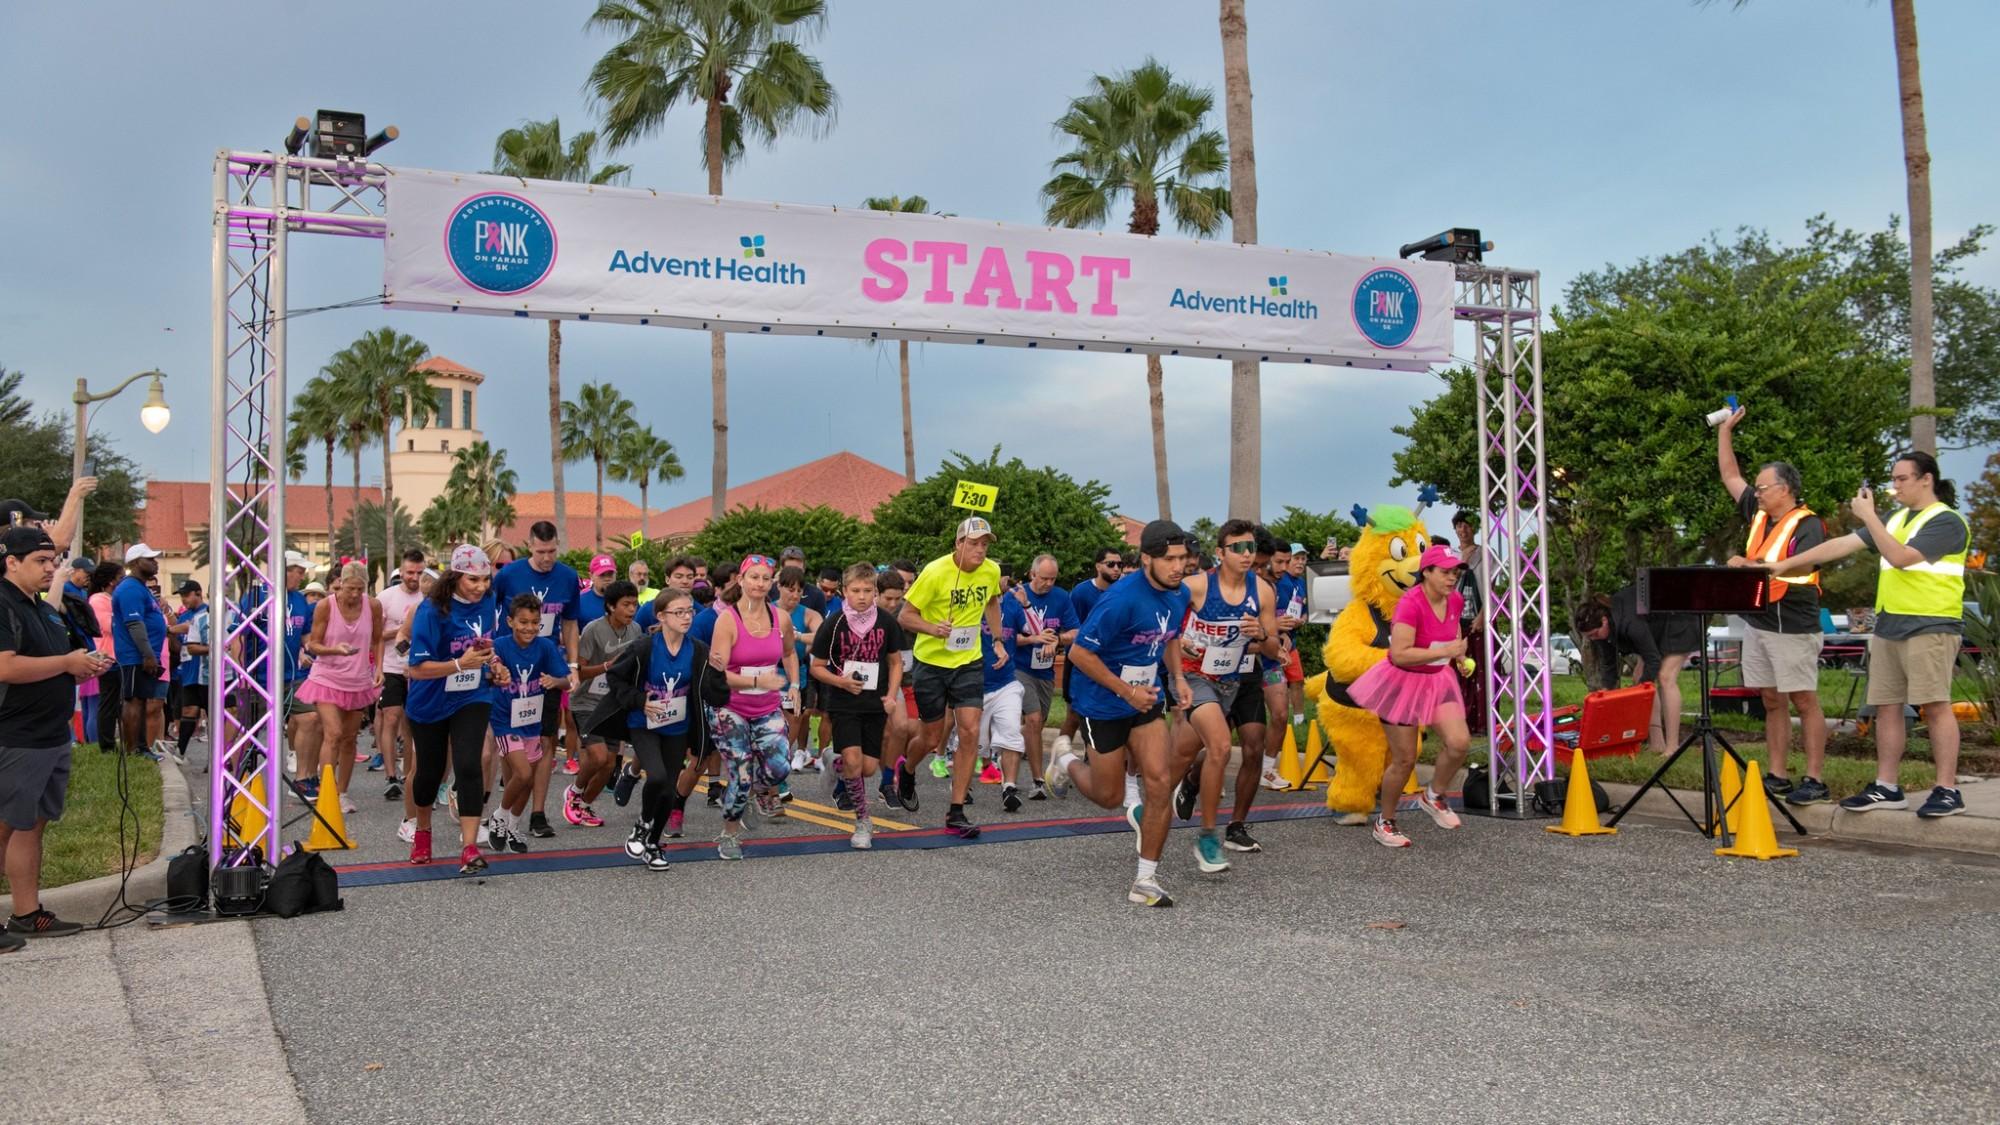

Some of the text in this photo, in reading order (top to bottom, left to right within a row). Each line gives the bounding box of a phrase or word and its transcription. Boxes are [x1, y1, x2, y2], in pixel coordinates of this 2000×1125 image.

[462, 199, 542, 226] ADVENTHEALTH
[491, 256, 529, 265] PARADE
[608, 249, 807, 285] AdventHealth
[861, 237, 1131, 317] START
[1169, 287, 1318, 319] AdventHealth
[960, 490, 989, 508] 7:30
[950, 584, 988, 608] BEAST
[955, 637, 970, 646] 697
[1213, 659, 1232, 668] 946
[455, 672, 476, 683] 1395
